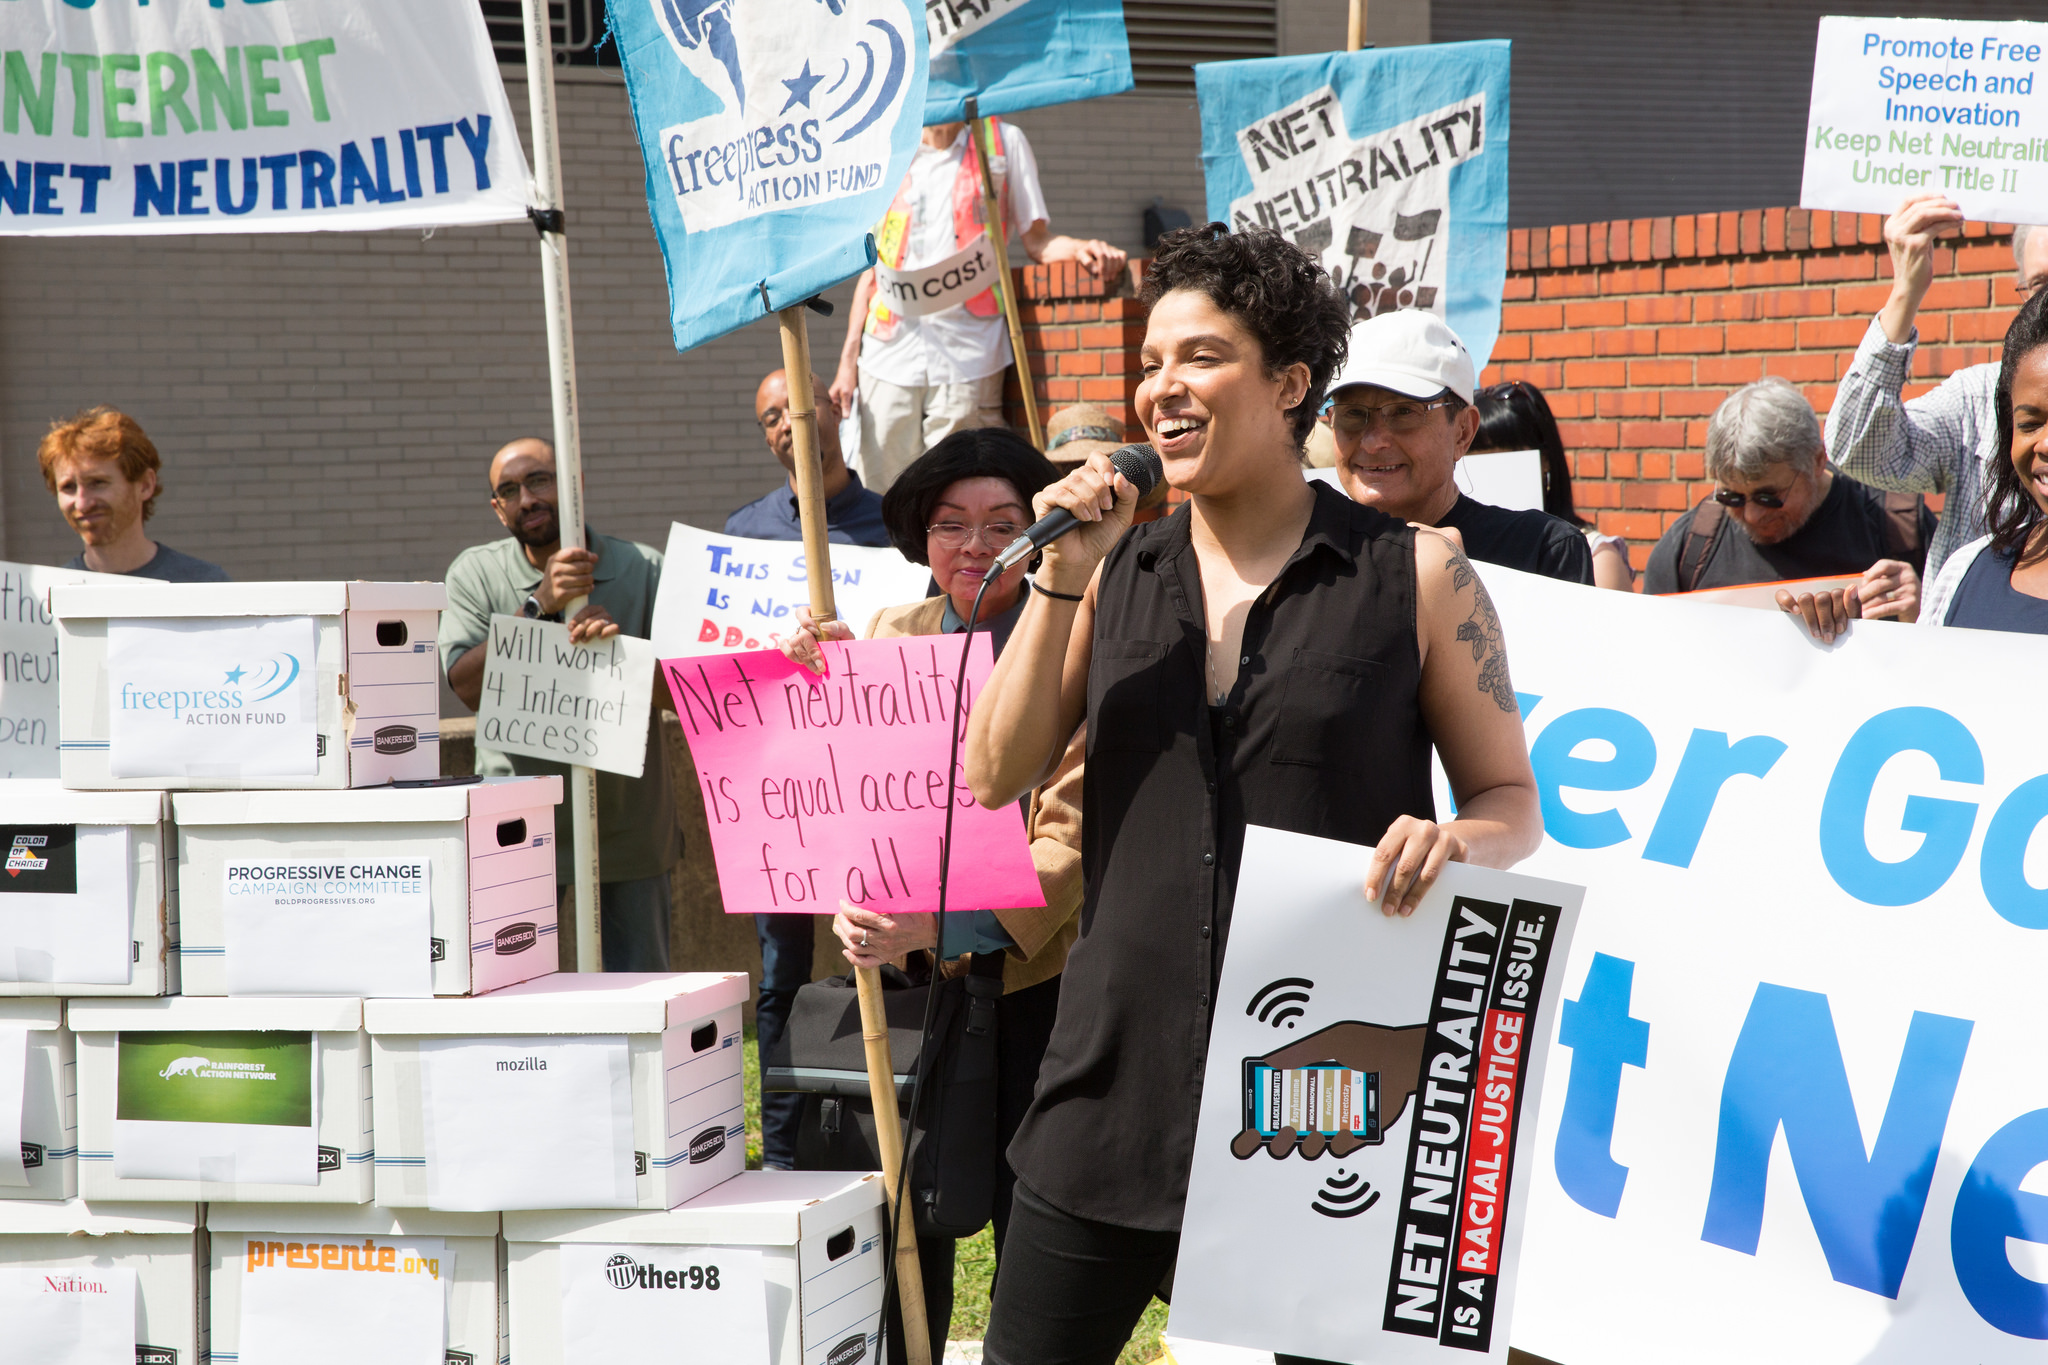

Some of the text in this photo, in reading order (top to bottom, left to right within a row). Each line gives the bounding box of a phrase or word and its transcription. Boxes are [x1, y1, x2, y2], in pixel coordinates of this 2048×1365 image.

[1863, 33, 2042, 63] Promote Free
[0, 37, 336, 139] NTERNET
[1878, 65, 2034, 96] Speech and
[1885, 97, 2021, 128] Innovation
[1246, 95, 1336, 173] NET
[1815, 125, 1882, 157] Keep
[1888, 129, 1933, 156] Net
[133, 114, 492, 217] NEUTRALITY
[667, 118, 822, 202] freepress
[1234, 103, 1482, 235] NEUTRALITY
[1852, 159, 2019, 193] Under Title II
[747, 162, 882, 210] ACTION FUND
[493, 622, 624, 681] Will work
[120, 682, 243, 719] freepress
[486, 671, 631, 726] 4 Internet
[669, 643, 971, 744] Net neutrality
[185, 712, 287, 726] ACTION FUND
[376, 733, 415, 746] BANKERS BOX
[484, 716, 599, 758] access
[702, 771, 741, 825] is
[761, 743, 845, 848] equal
[12, 848, 25, 856] OF
[15, 836, 46, 845] COLOR
[8, 859, 45, 868] CHANGE
[227, 864, 422, 881] PROGRESSIVE CHANGE
[759, 841, 821, 907] for
[227, 881, 422, 896] CAMPAIGN COMMITTEE
[274, 897, 376, 906] BOLDPROGRESSIVES.ORG
[497, 930, 534, 948] BANKERS BOX
[199, 1070, 277, 1081] ACTION NETWORK
[211, 1062, 266, 1072] RAINFOREST
[495, 1056, 548, 1072] mozilla
[1272, 1071, 1282, 1130] #BLACKLIVESMATTER
[1325, 1085, 1333, 1116] #noDAPL
[1341, 1084, 1352, 1124] #heretostay
[1393, 905, 1498, 1324] NET NEUTRALITY
[713, 1133, 724, 1146] BOX
[1452, 914, 1546, 1336] IS A RACIAL JUSTICE ISSUE.
[247, 1239, 440, 1281] presente.org
[42, 1275, 108, 1294] Nation.
